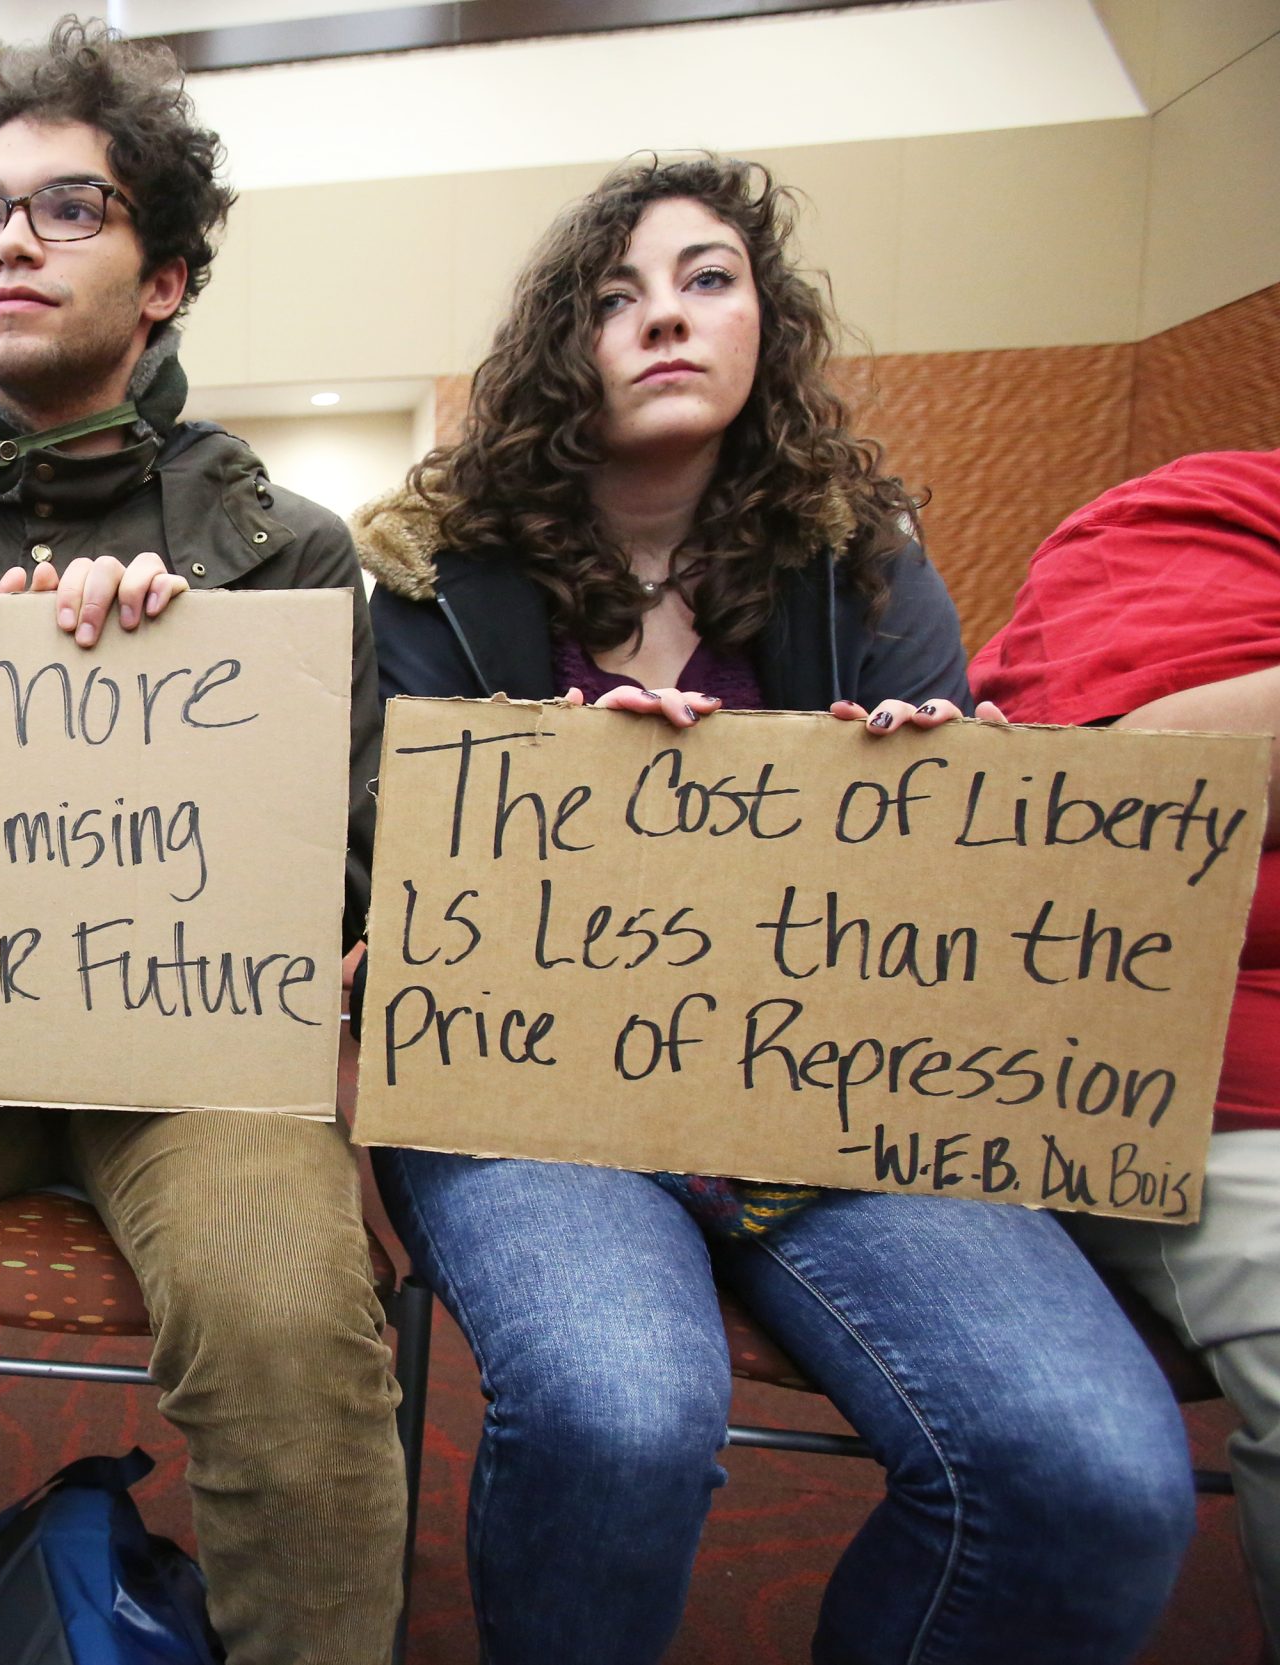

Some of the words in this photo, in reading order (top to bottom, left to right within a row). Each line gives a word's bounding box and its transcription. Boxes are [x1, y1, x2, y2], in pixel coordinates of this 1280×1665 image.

[395, 728, 596, 861] The
[626, 747, 802, 840] Cost
[954, 769, 1247, 886] Liberty
[71, 918, 322, 1026] Future
[534, 879, 712, 969] Less
[755, 885, 978, 987] than
[1010, 900, 1173, 993] the
[736, 997, 1178, 1134] Repression
[1041, 1133, 1099, 1207] Du
[1109, 1142, 1192, 1218] Bois
